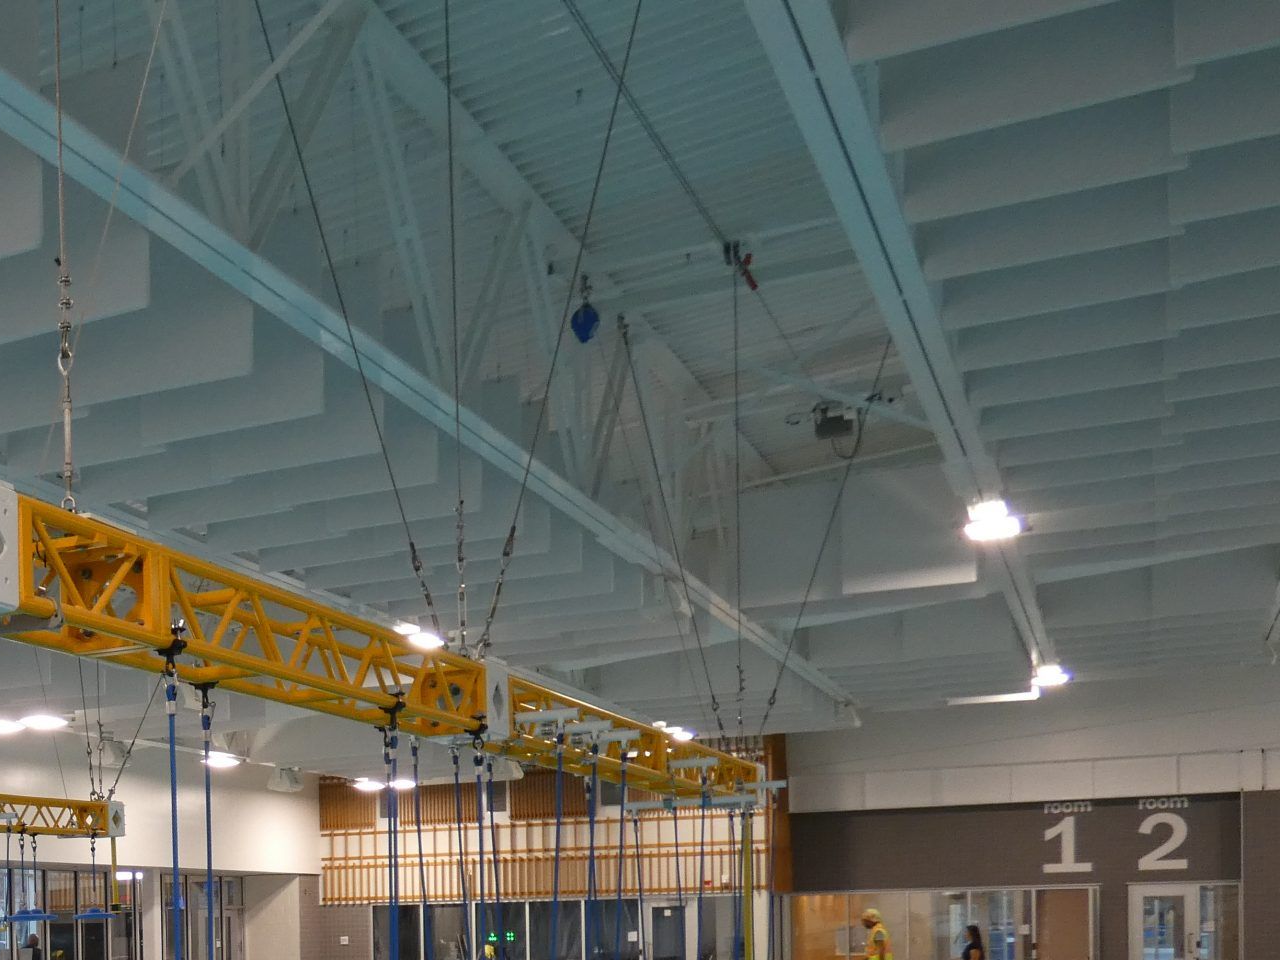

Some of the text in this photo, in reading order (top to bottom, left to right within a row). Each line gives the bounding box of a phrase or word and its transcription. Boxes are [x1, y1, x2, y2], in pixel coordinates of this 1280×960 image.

[1043, 801, 1093, 814] room
[1138, 796, 1189, 810] room
[1042, 815, 1093, 873] 1
[1137, 812, 1188, 871] 2
